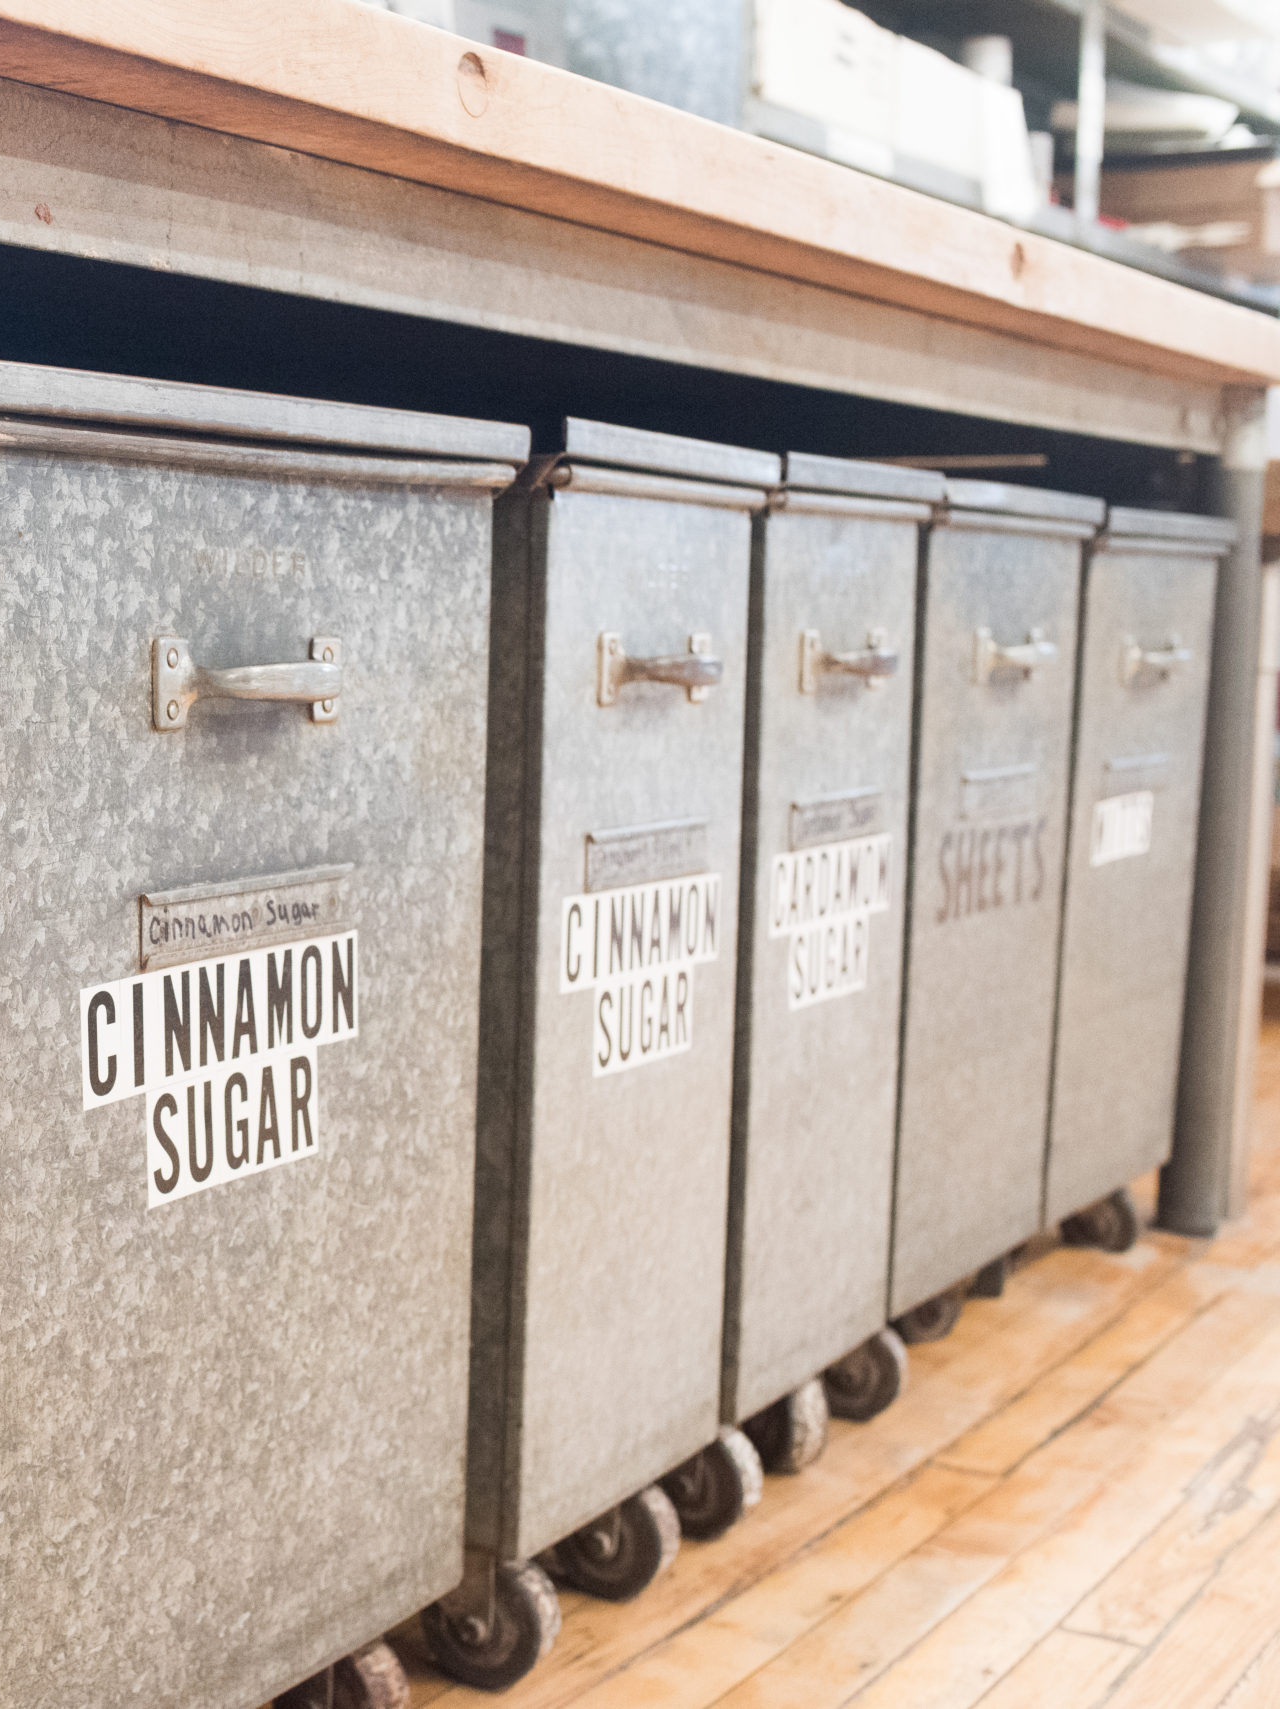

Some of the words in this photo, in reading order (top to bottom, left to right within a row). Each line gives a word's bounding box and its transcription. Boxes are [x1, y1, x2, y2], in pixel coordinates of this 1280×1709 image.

[266, 899, 320, 927] Sugar
[934, 815, 1047, 925] SHEETS
[566, 881, 718, 983] CINNAMON
[793, 919, 864, 999] SUGAR
[86, 938, 356, 1097] CINNAMON
[598, 972, 689, 1068] SUGAR
[152, 1055, 315, 1196] SUGAR
